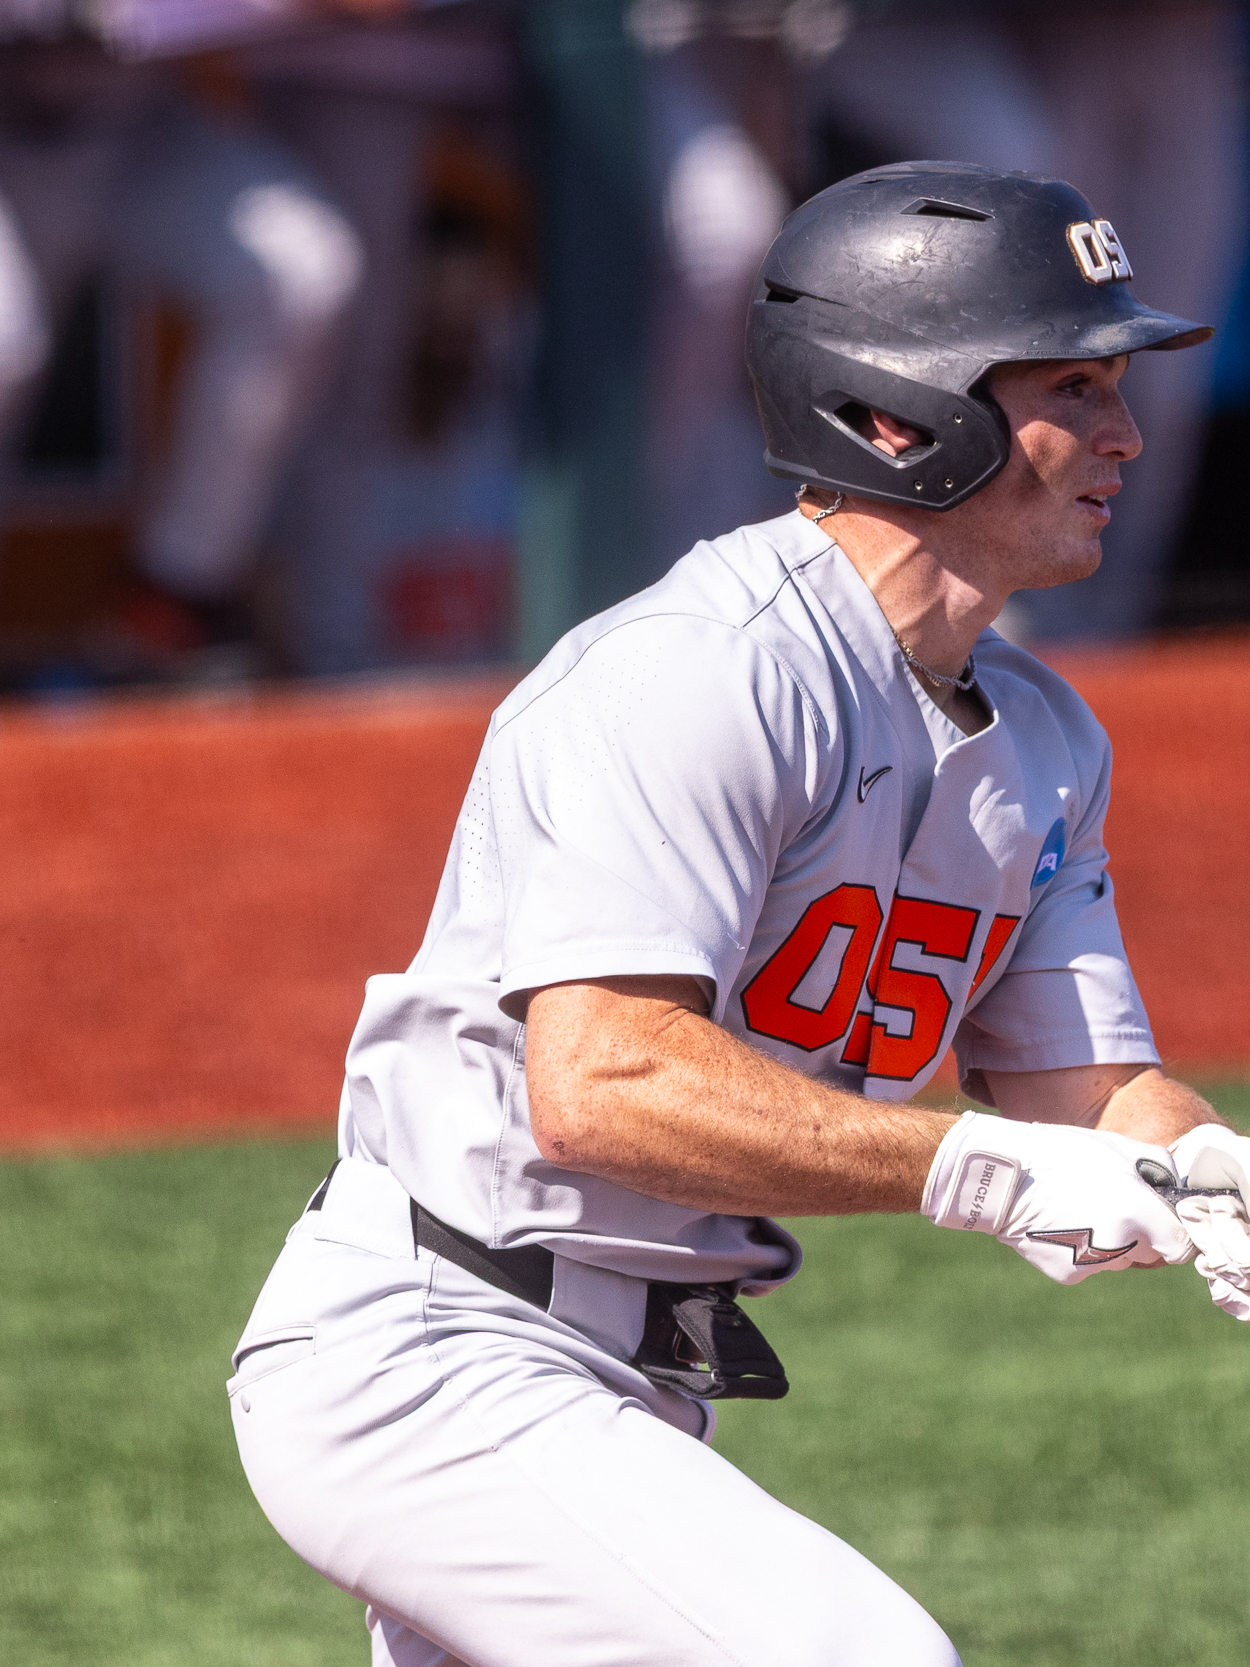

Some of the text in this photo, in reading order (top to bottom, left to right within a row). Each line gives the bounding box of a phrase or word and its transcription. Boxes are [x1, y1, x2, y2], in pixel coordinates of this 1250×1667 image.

[1066, 218, 1134, 284] OS
[740, 882, 1022, 1082] OS
[963, 1162, 997, 1230] BRUCE BOLT
